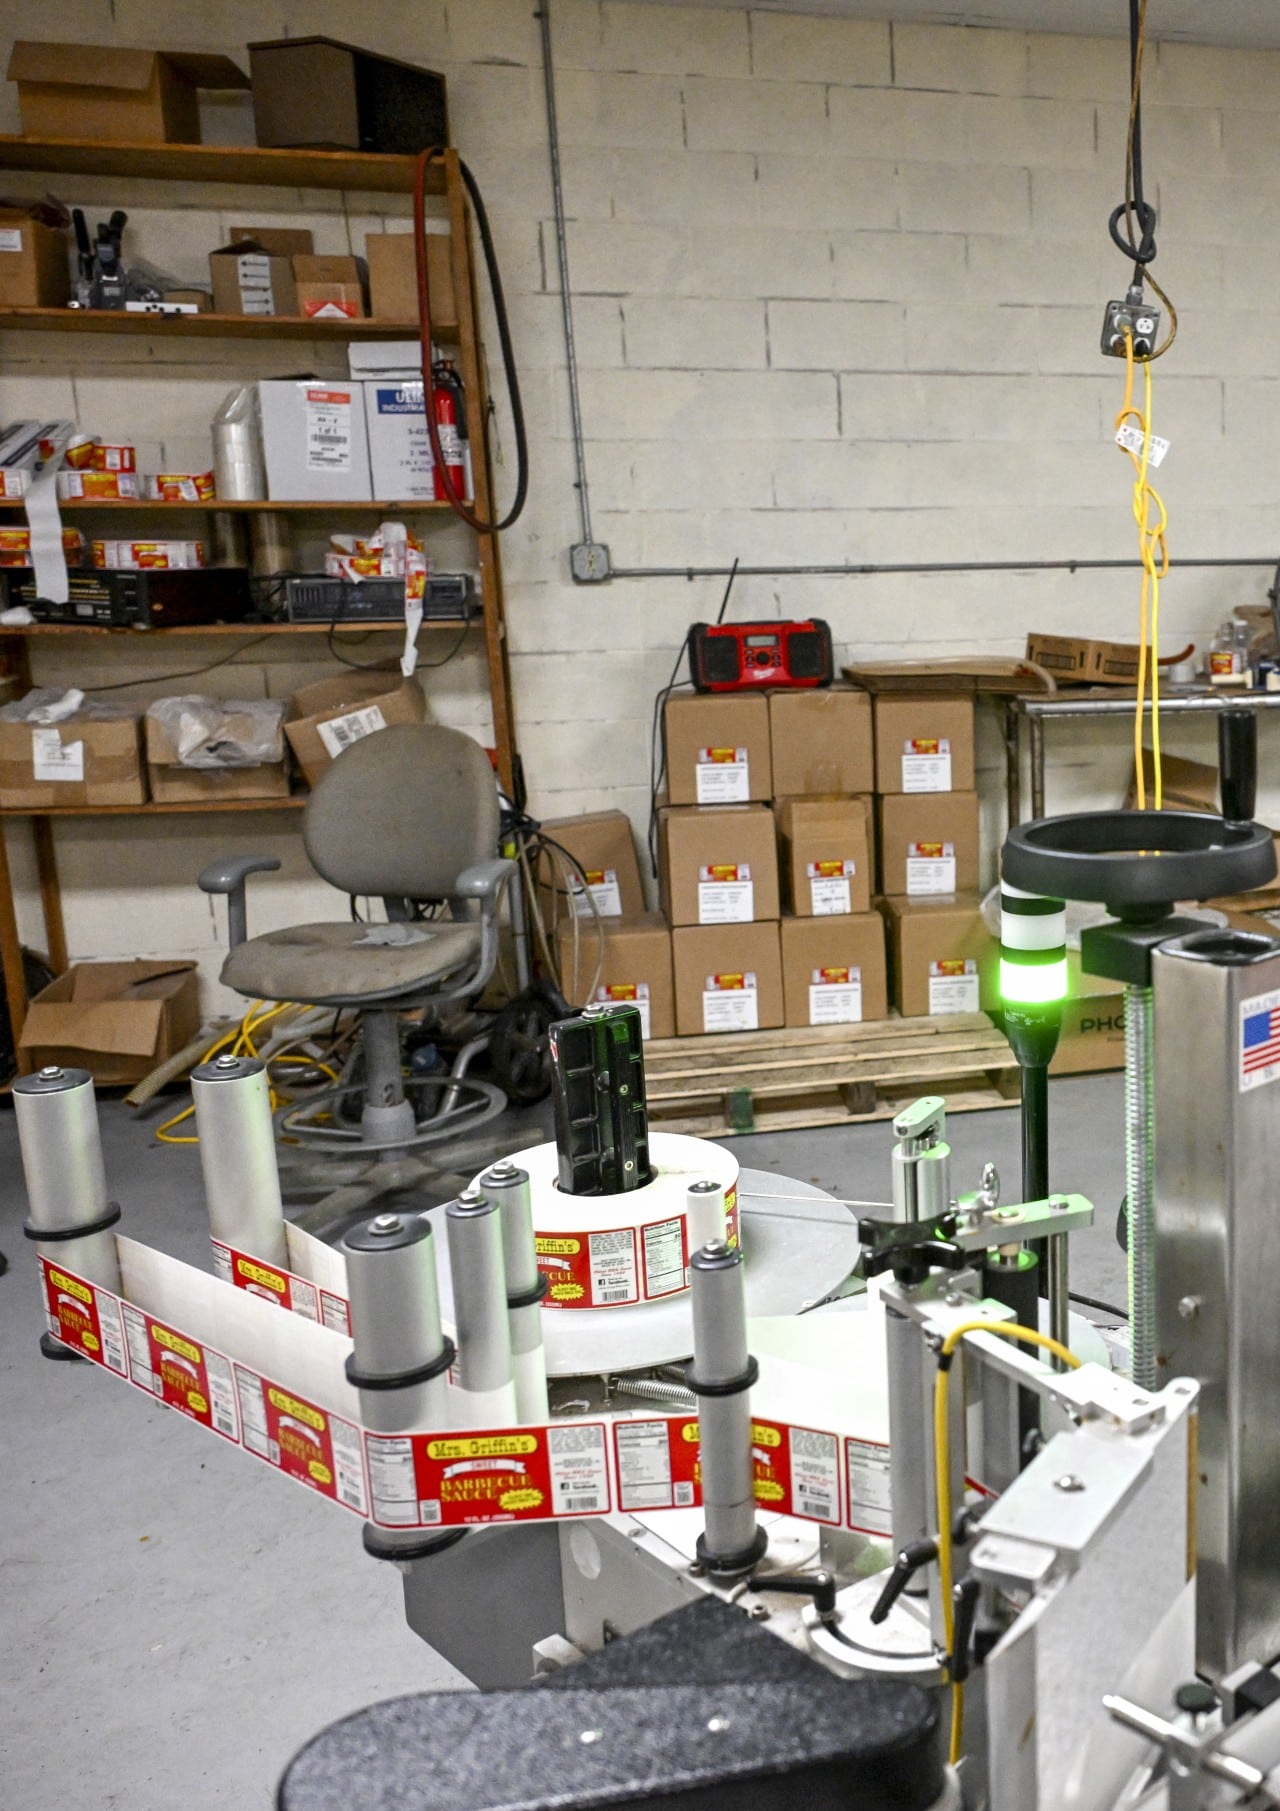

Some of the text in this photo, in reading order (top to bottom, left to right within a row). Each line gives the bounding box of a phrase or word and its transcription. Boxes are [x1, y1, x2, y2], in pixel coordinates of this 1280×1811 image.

[395, 391, 425, 403] ULIN
[382, 403, 426, 412] INDUSTRIA
[1081, 1015, 1126, 1033] PHO
[537, 1239, 574, 1253] riffin's
[433, 1437, 530, 1457] Mrs. Griffin's
[472, 1460, 497, 1469] SWEET
[440, 1474, 532, 1491] BARBECUE
[440, 1489, 498, 1503] SAUCE
